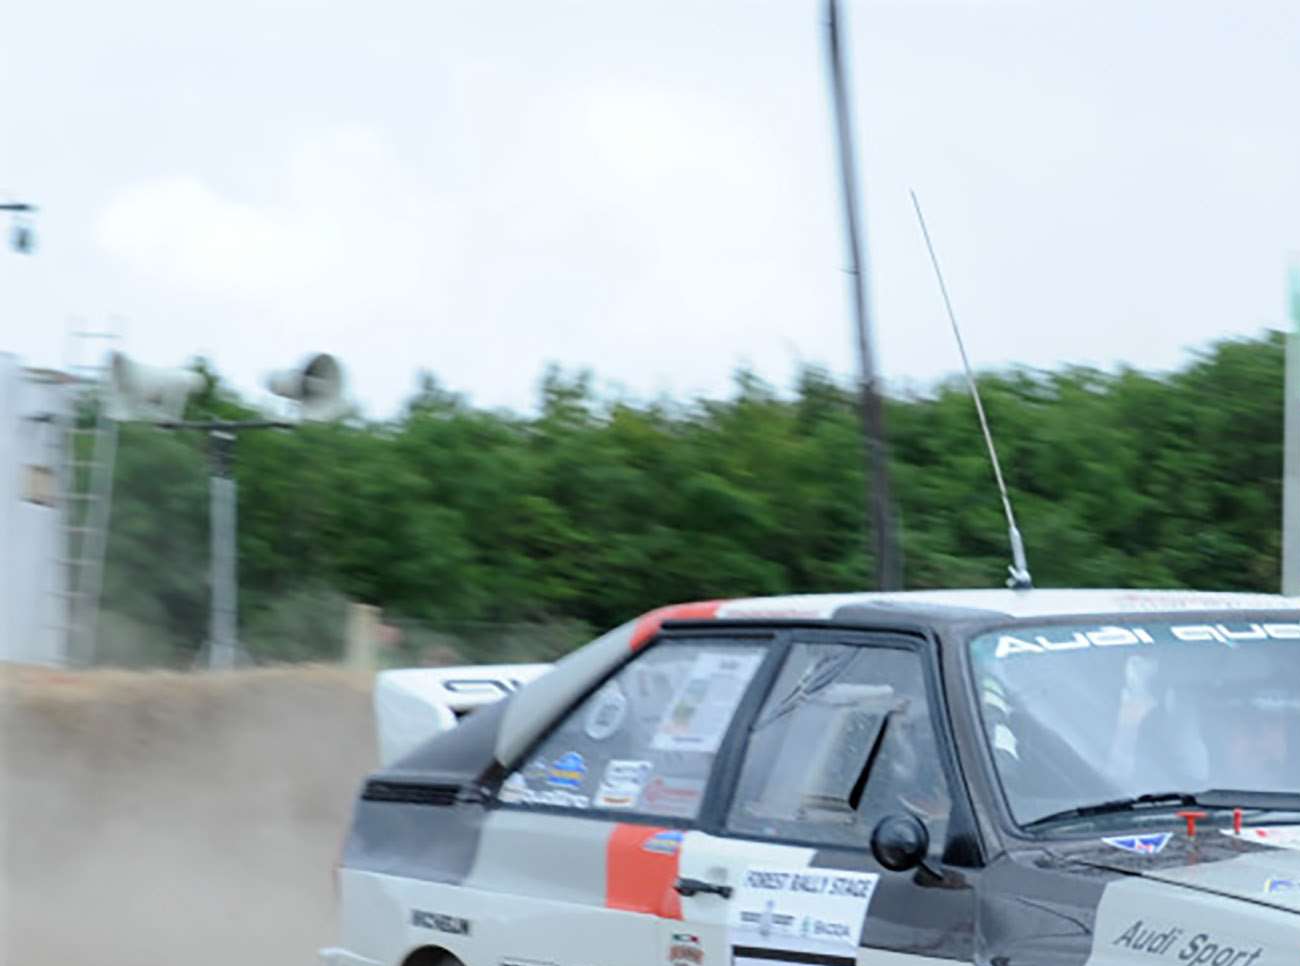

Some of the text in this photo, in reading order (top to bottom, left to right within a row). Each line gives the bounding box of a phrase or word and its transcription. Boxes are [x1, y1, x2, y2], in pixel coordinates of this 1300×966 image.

[745, 871, 872, 897] FOREST RALLY STAGE
[1113, 921, 1177, 954] Audi
